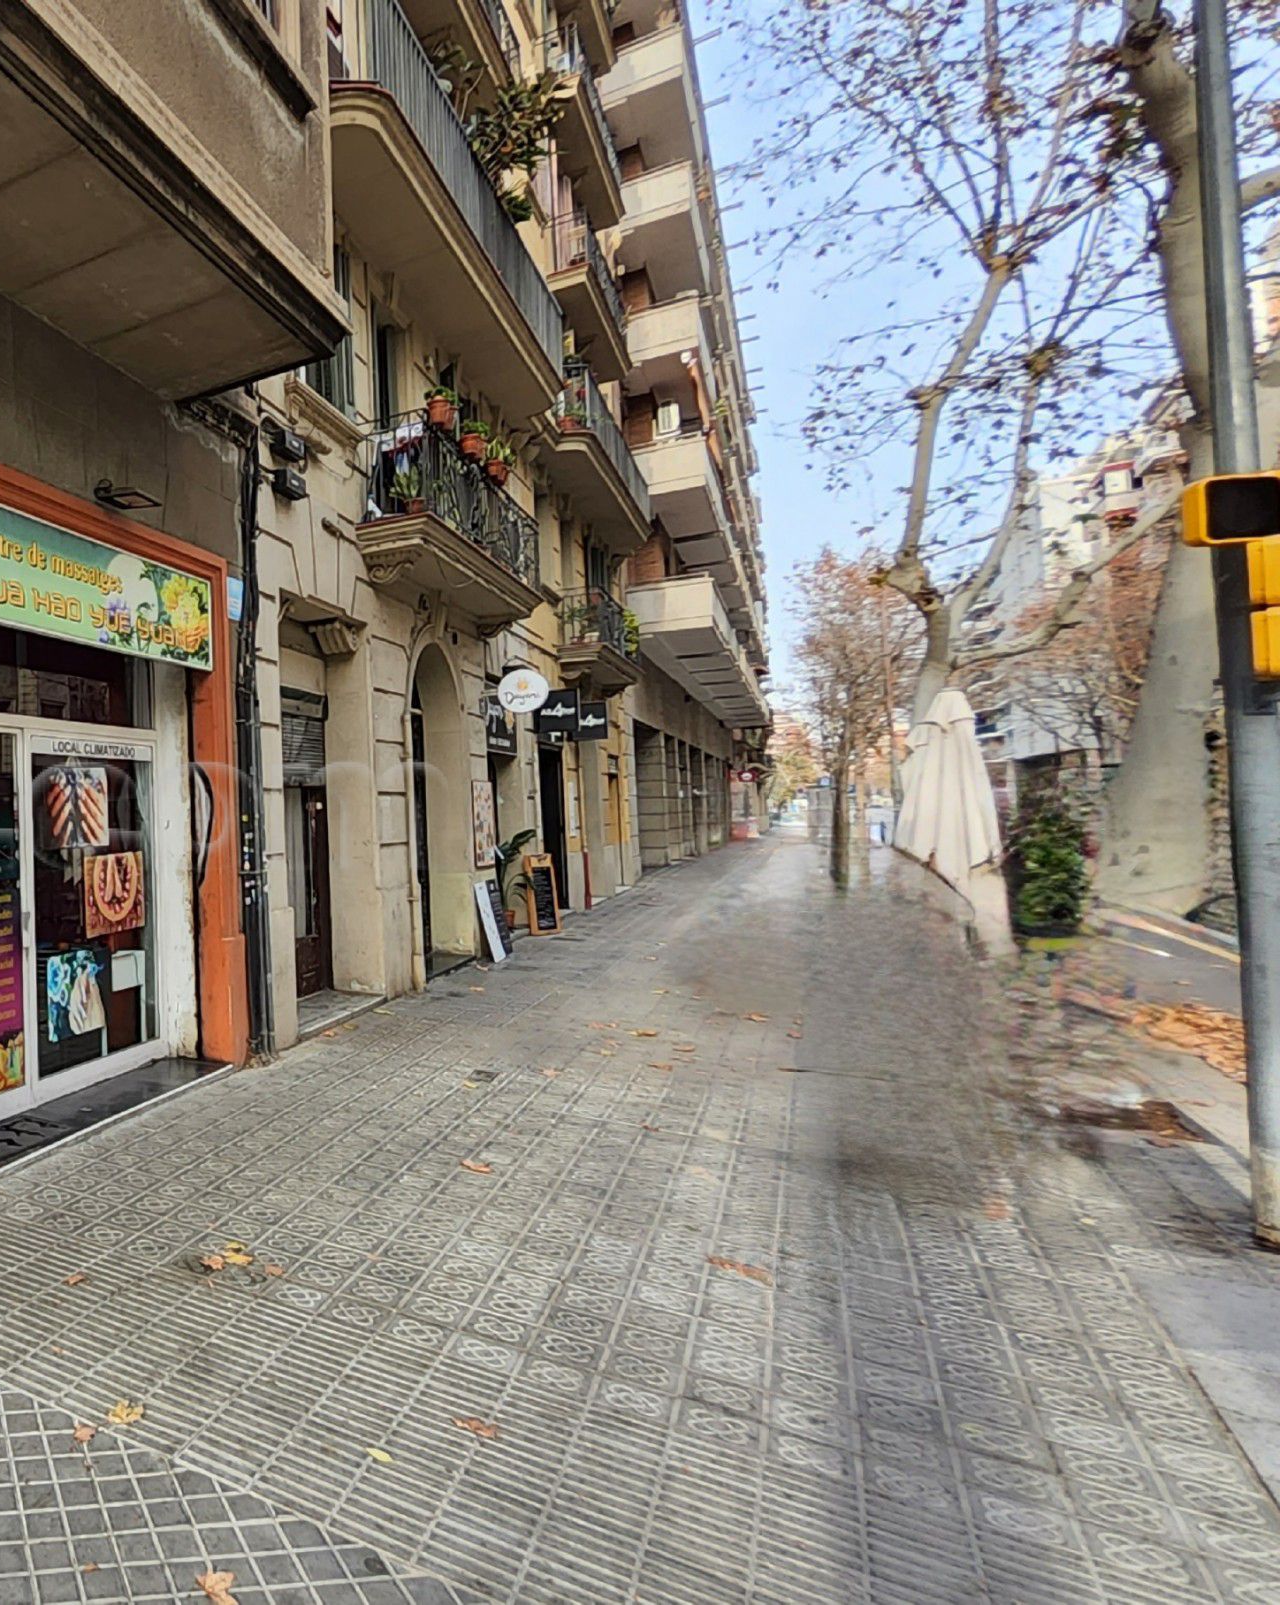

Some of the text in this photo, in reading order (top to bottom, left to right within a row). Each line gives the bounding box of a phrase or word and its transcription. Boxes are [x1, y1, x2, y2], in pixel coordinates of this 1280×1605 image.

[27, 541, 47, 570] de
[51, 554, 123, 595] massatges
[52, 741, 136, 758] LOCAL CLIMATIZADO
